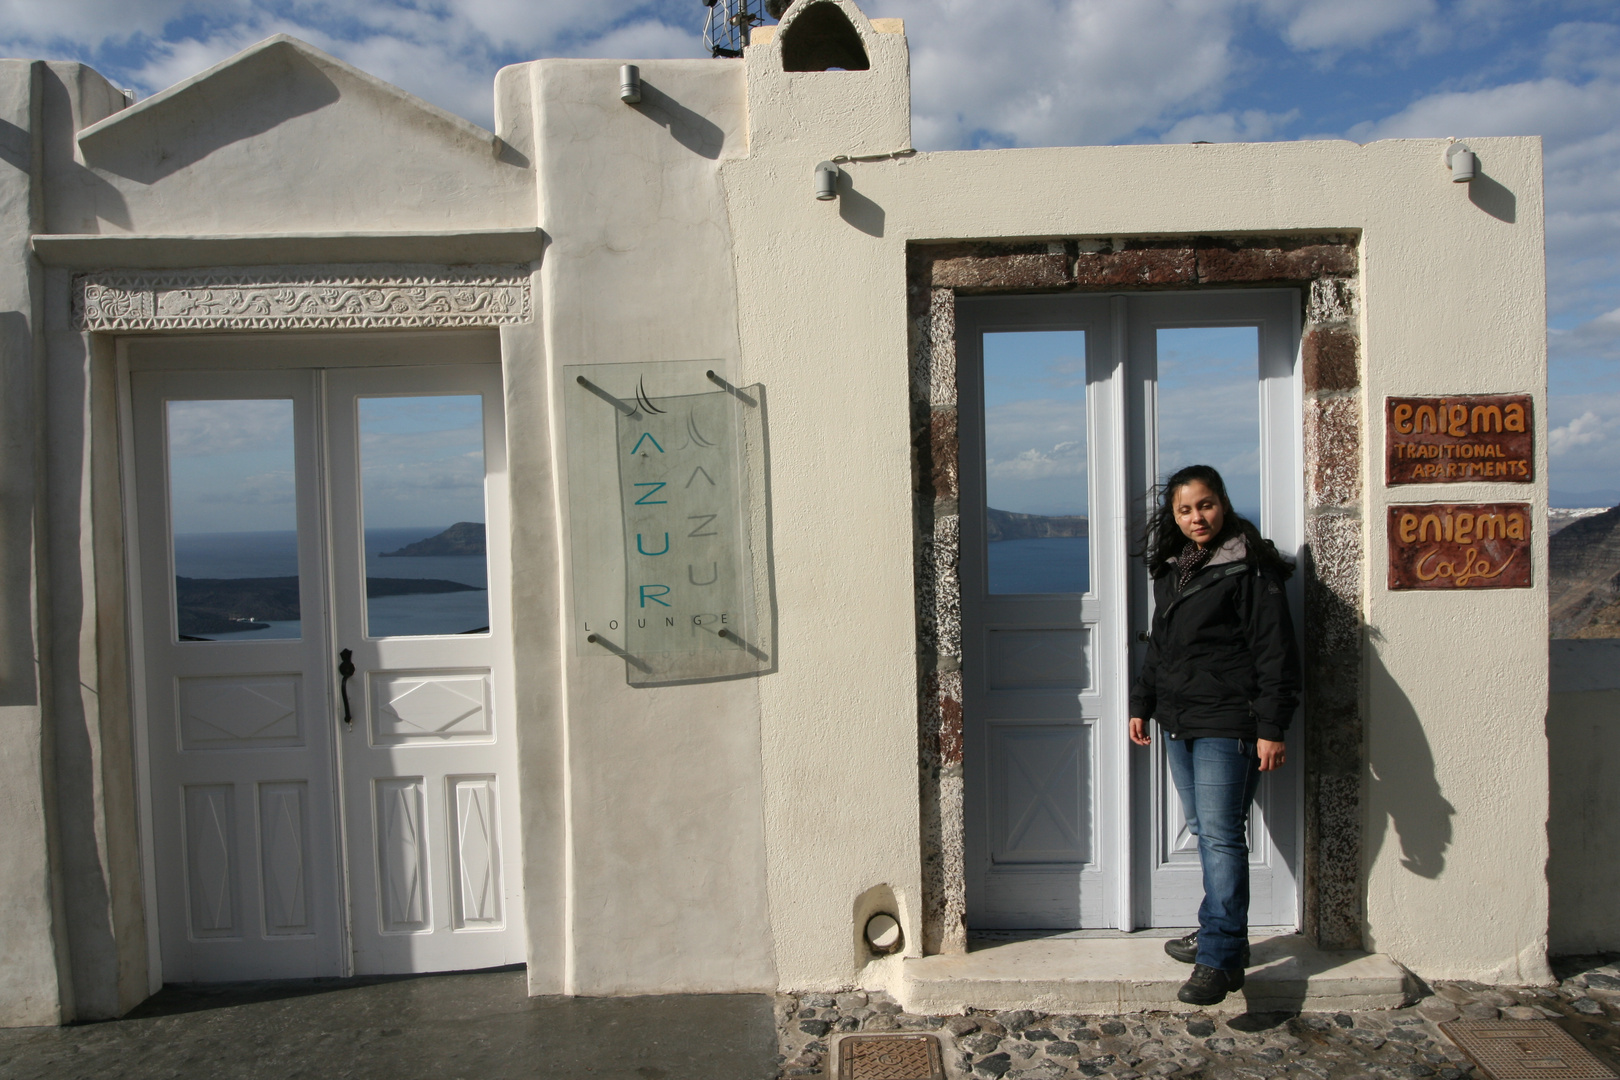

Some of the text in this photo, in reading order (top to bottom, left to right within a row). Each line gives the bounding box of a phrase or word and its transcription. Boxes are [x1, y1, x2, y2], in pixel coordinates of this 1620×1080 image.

[1394, 399, 1526, 437] enigma
[1394, 443, 1506, 459] TRADITIONAL
[1411, 460, 1528, 478] APARTMENTS
[1400, 508, 1524, 544] enigma
[1417, 547, 1517, 587] Cafe
[584, 613, 728, 632] LOUNGE
